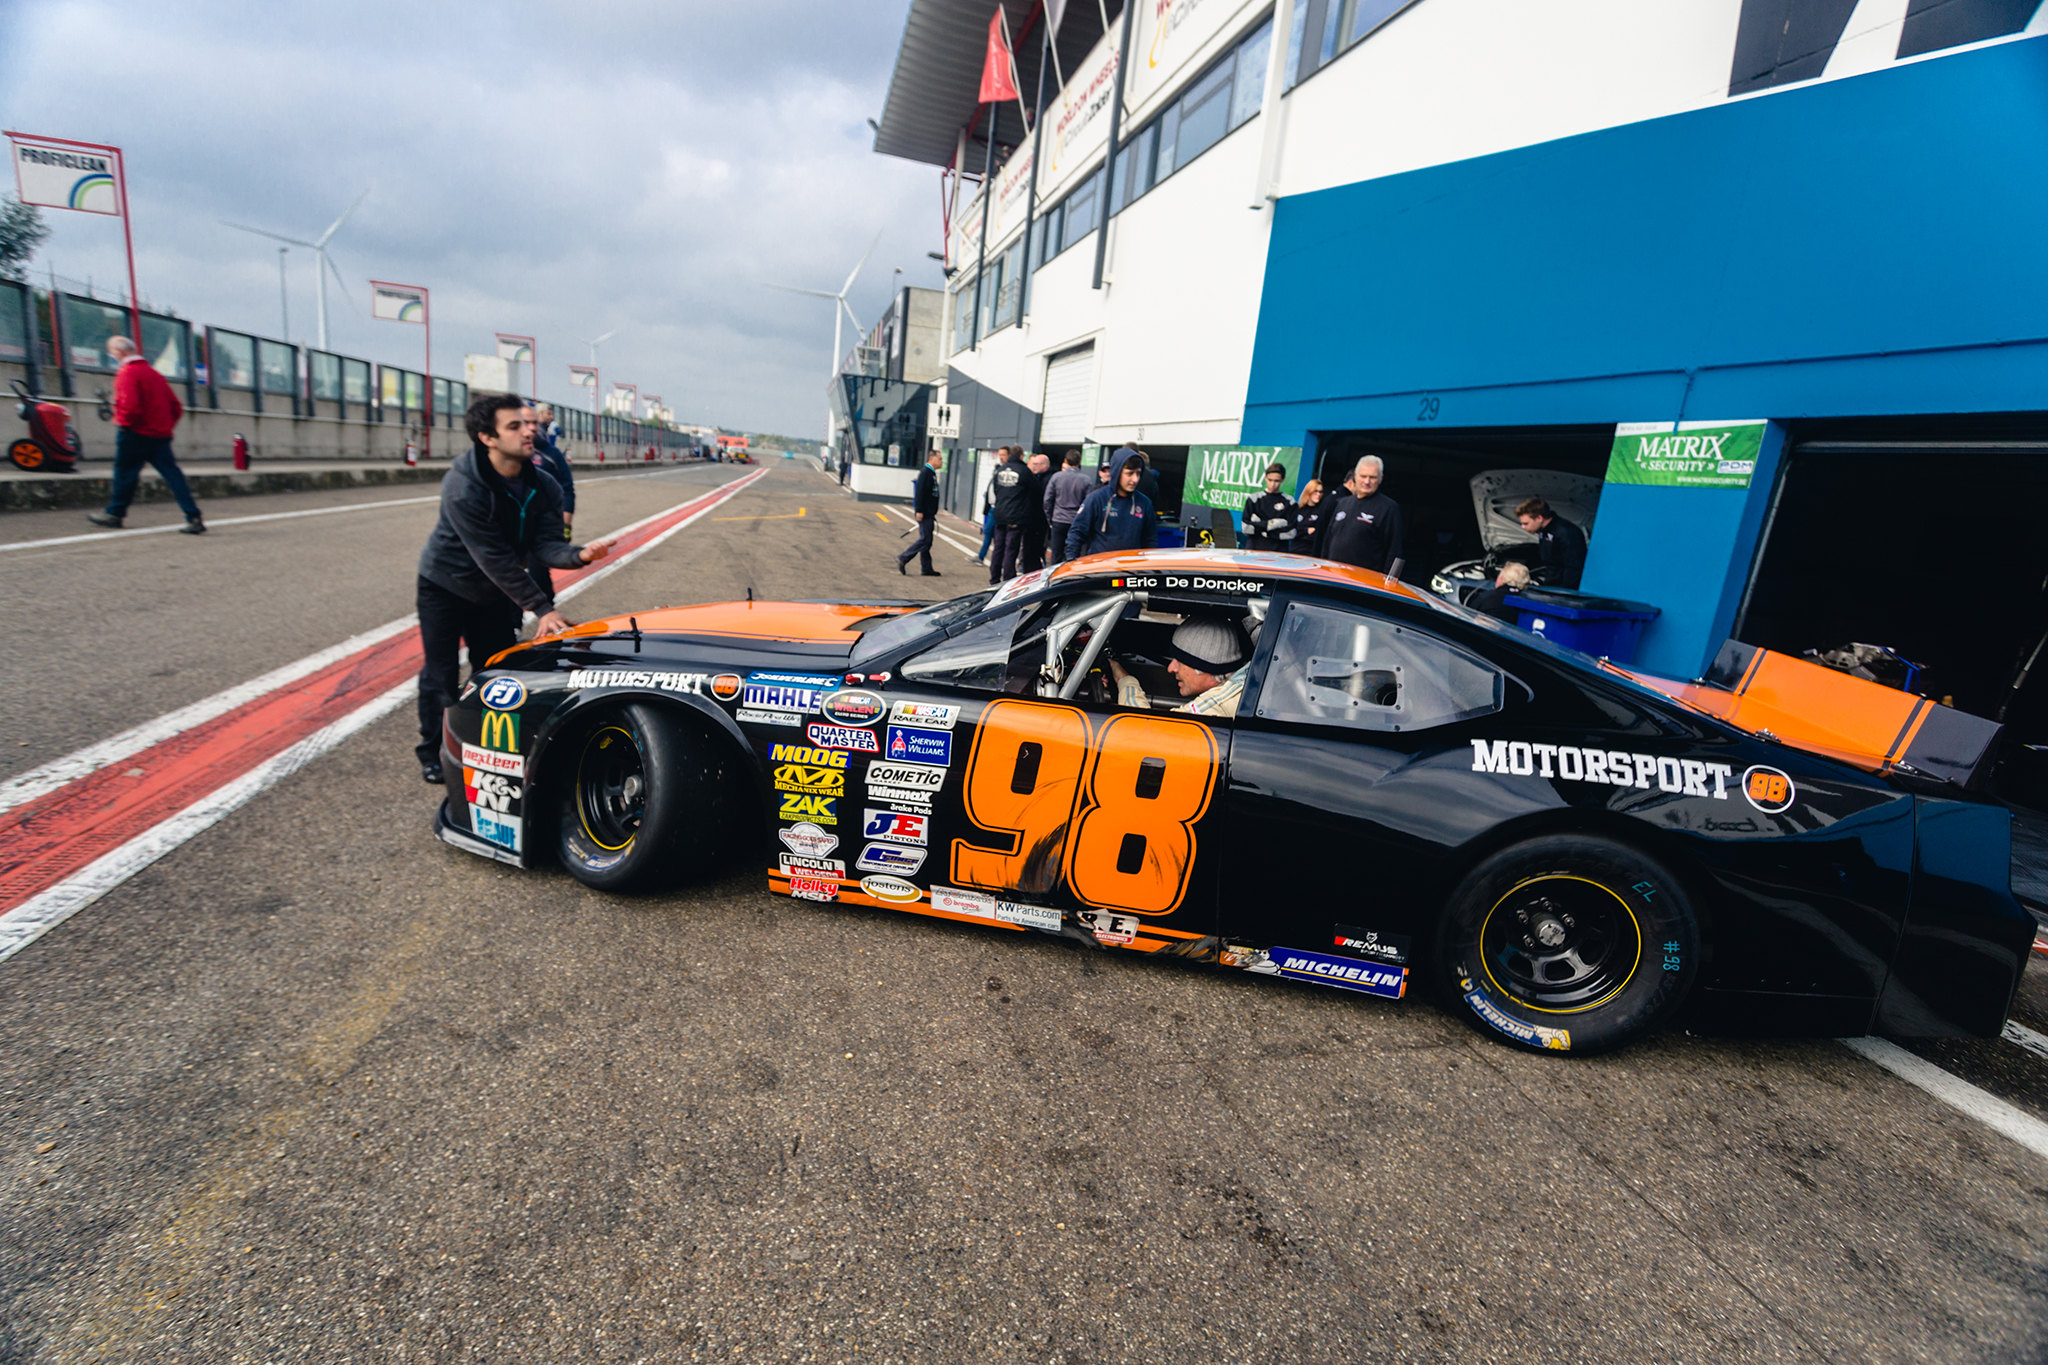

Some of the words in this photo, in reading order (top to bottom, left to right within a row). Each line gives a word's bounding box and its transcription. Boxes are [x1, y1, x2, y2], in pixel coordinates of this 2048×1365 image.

[20, 147, 107, 173] PROFICLEAN
[1416, 396, 1440, 421] 29
[929, 427, 958, 436] TOILETS
[1635, 432, 1732, 462] MATRIX
[1198, 447, 1282, 489] MATRIX
[1649, 460, 1707, 472] SECURITY
[1126, 577, 1157, 588] Eric
[1166, 577, 1188, 588] De
[1193, 577, 1264, 592] Doncker
[567, 669, 707, 695] MOTORSPORT
[715, 676, 738, 694] 98
[486, 684, 517, 704] FJ
[745, 685, 822, 709] MAHLE
[893, 714, 922, 724] RACE
[924, 718, 948, 726] CAR
[810, 725, 873, 741] QUARTER
[909, 735, 945, 747] SHERWIN
[820, 736, 876, 750] MASTER
[464, 750, 521, 770] nexteer
[771, 744, 849, 768] MOOG
[870, 767, 942, 785] COMETIC
[1470, 739, 1731, 800] MOTORSPORT
[774, 780, 818, 795] MECHANIX
[818, 788, 844, 797] WEAR
[1749, 772, 1788, 802] 98
[780, 793, 836, 817] ZAK
[890, 803, 912, 812] Brake
[914, 806, 932, 815] Pads
[951, 698, 1220, 917] 98
[866, 813, 924, 837] JE
[883, 834, 926, 844] PISTONS
[783, 855, 833, 871] LINCOLN
[790, 877, 838, 896] Holley
[866, 878, 911, 893] jostens
[1632, 881, 1656, 902] EL
[791, 890, 833, 902] MSD
[953, 900, 979, 909] brembo
[1021, 917, 1046, 927] American
[1342, 938, 1398, 955] REMUS
[1284, 957, 1401, 987] MICHELIN
[1470, 995, 1534, 1040] MICHELIN
